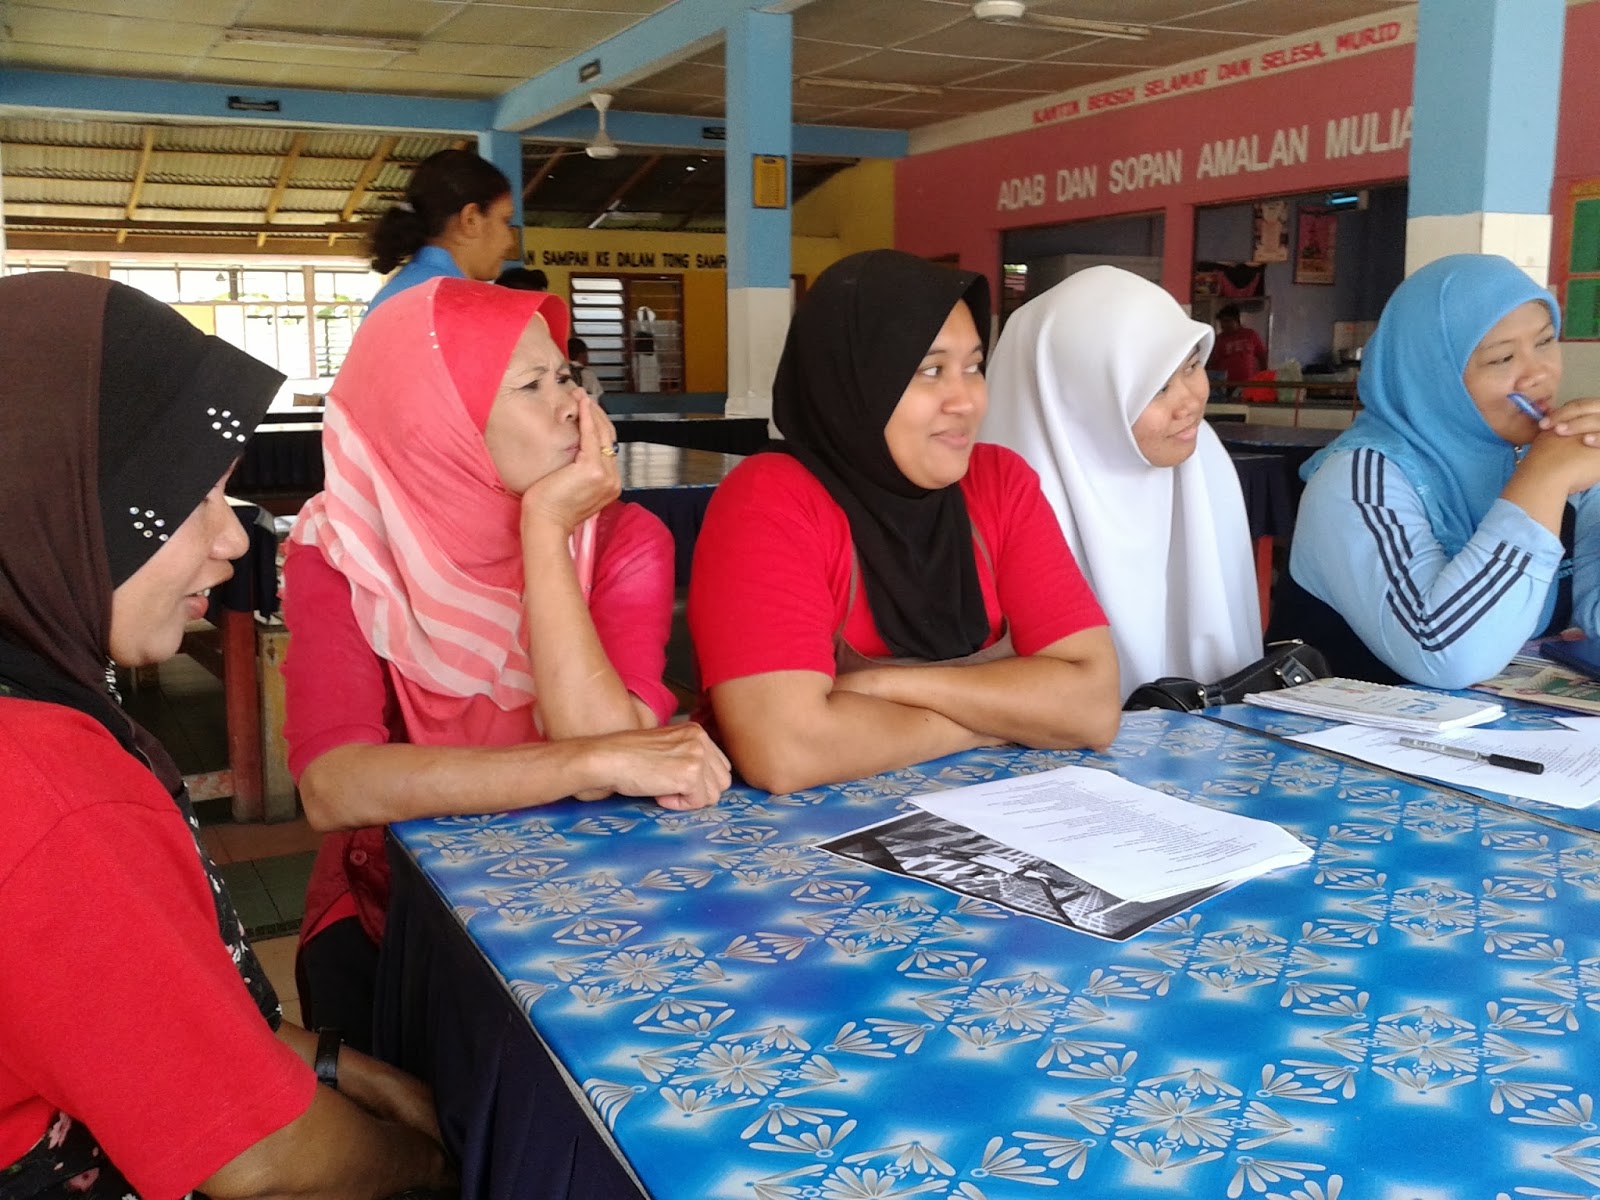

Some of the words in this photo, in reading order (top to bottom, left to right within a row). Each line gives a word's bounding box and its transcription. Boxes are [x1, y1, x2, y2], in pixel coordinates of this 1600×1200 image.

[1144, 68, 1208, 98] SELAMAT
[1217, 58, 1251, 80] DAN
[1336, 21, 1401, 53] MURID
[997, 174, 1046, 211] ADAB
[1056, 165, 1097, 202] DAN
[1108, 148, 1183, 194] SOPAN
[1196, 124, 1310, 179] AMALAN
[543, 249, 589, 267] SAMPAH
[596, 251, 610, 267] KE
[617, 251, 655, 268] DALAM
[662, 252, 689, 269] TONG
[696, 253, 728, 269] SAMP
